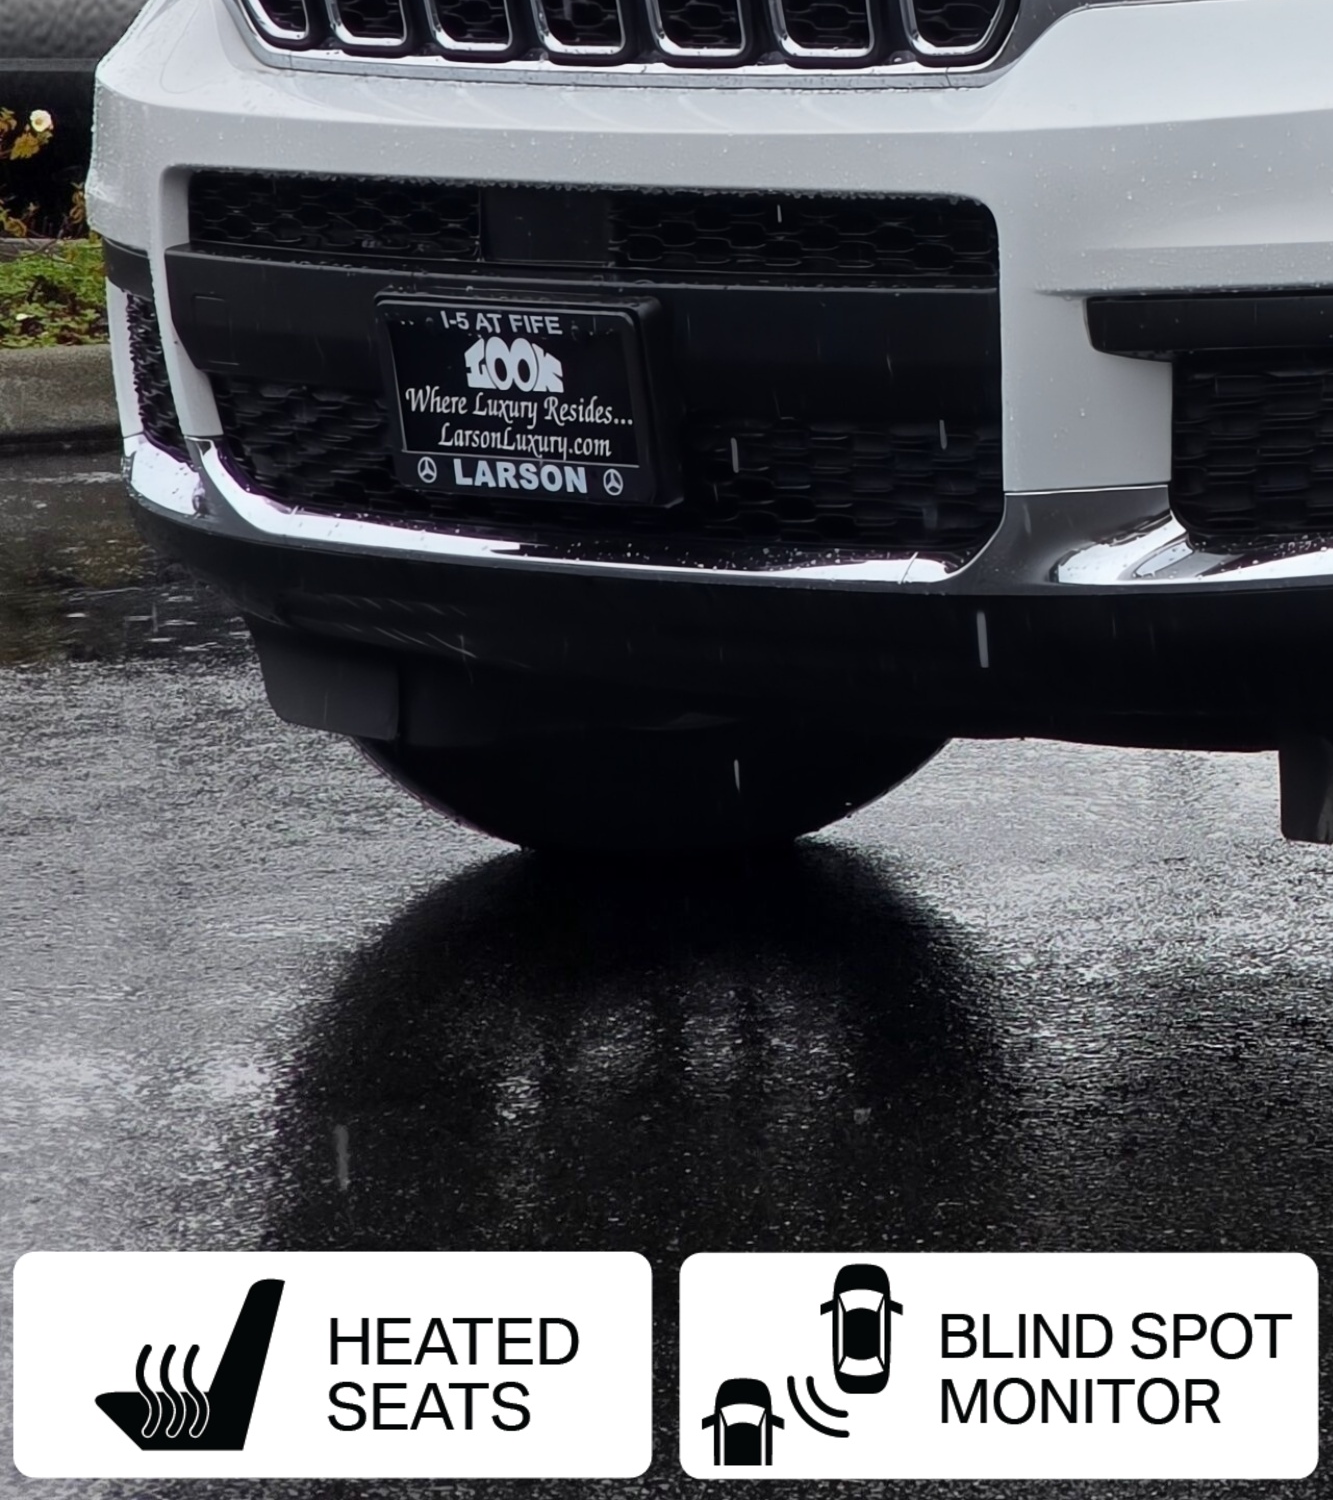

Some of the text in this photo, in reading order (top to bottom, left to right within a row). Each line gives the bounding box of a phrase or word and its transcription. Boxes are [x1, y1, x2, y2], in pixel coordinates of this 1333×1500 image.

[440, 310, 563, 335] I-5 AT FIFE
[405, 385, 634, 430] Where Luxury Resides...
[438, 423, 612, 460] LarsonLuxury.com
[453, 458, 588, 494] LARSON
